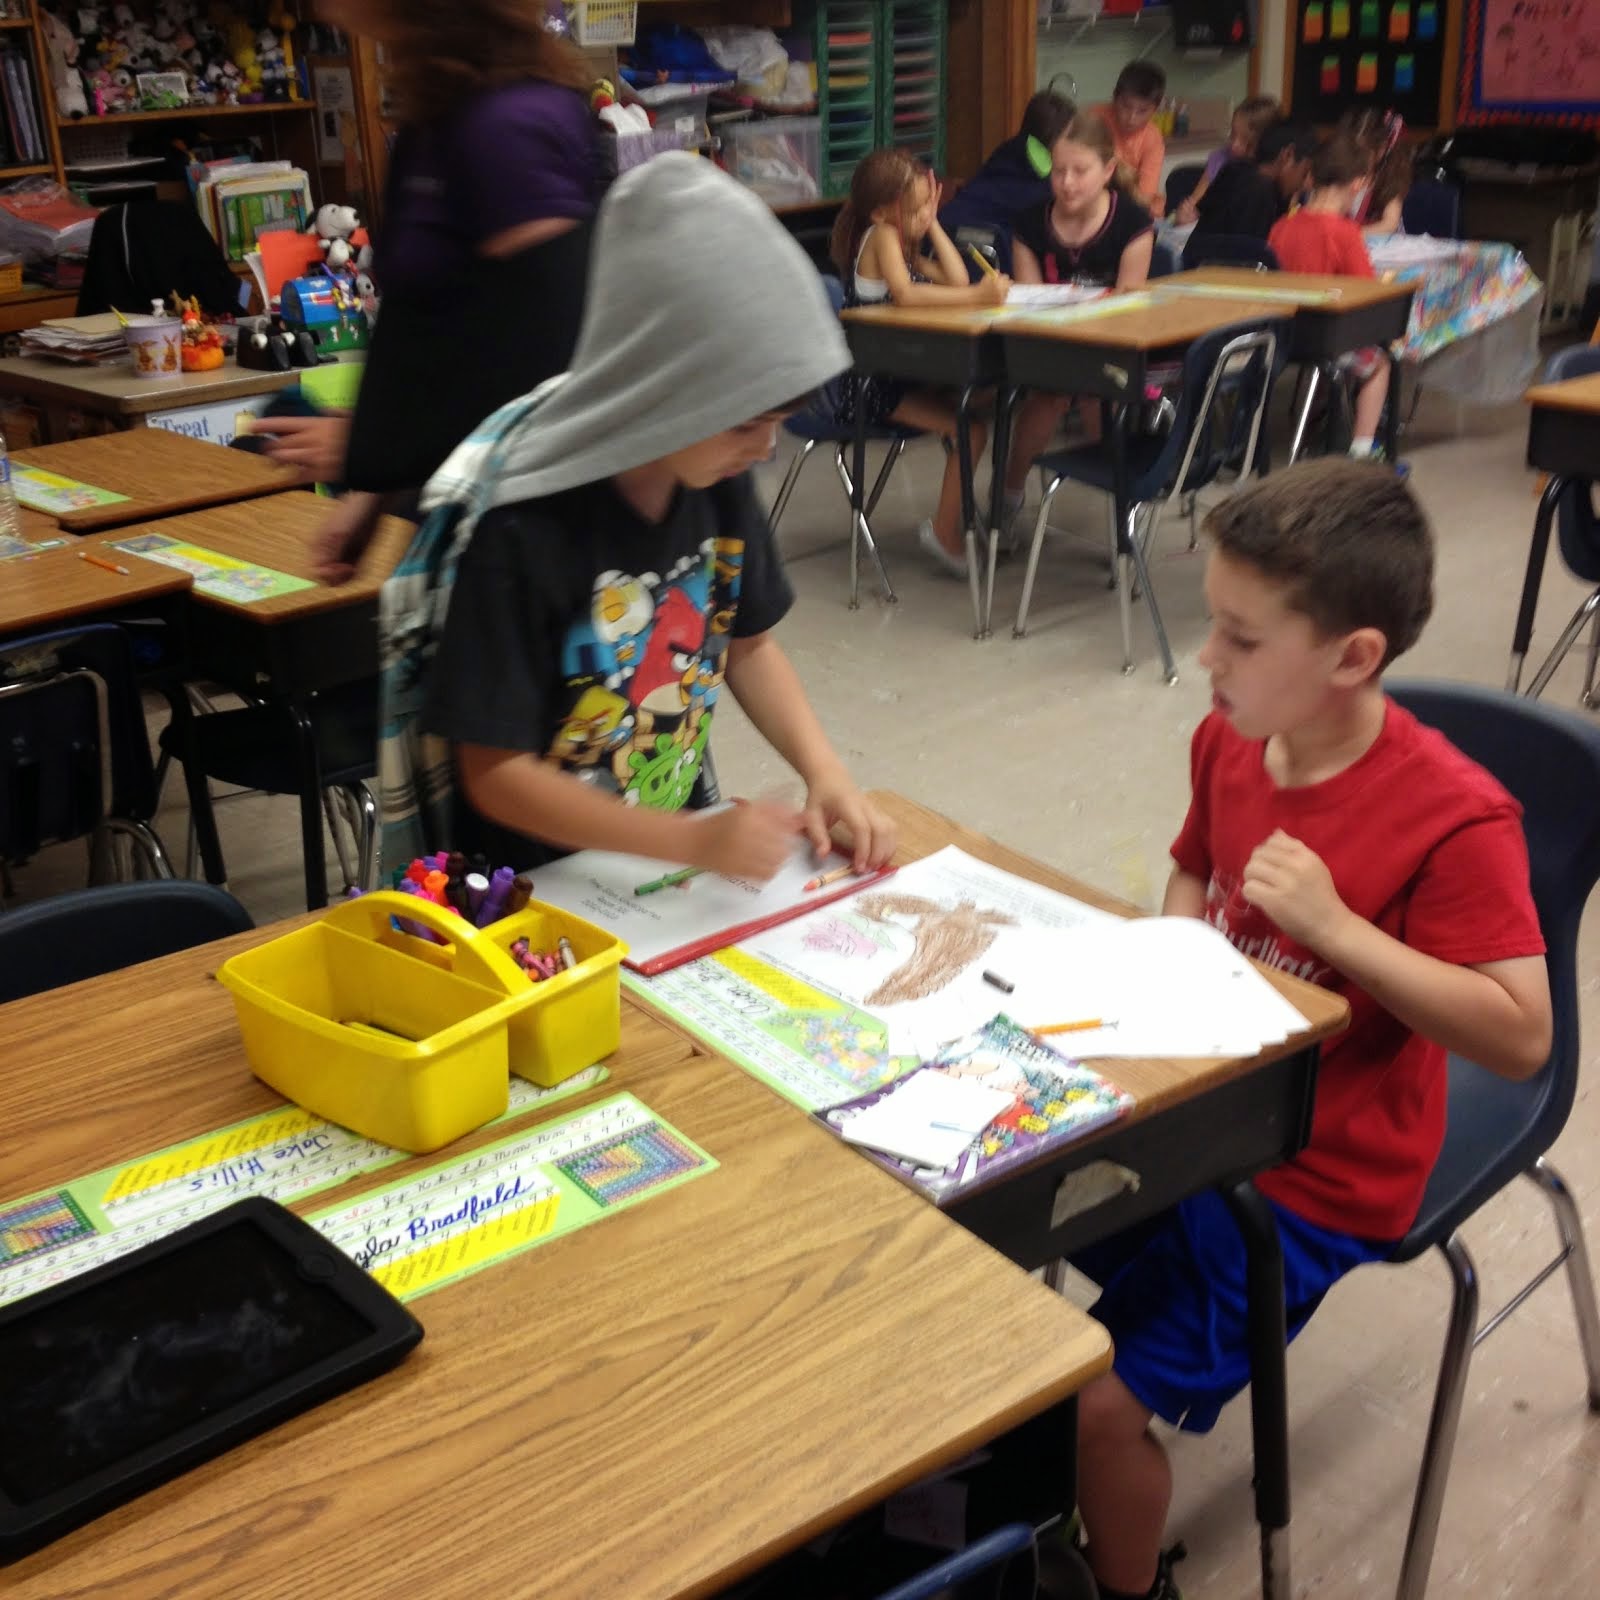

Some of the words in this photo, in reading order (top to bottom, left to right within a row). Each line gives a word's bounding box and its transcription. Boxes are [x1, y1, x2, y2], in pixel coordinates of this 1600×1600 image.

[159, 416, 209, 438] Treat
[272, 1133, 333, 1160] Jake
[188, 1157, 265, 1191] Hillis
[353, 1234, 400, 1268] yla
